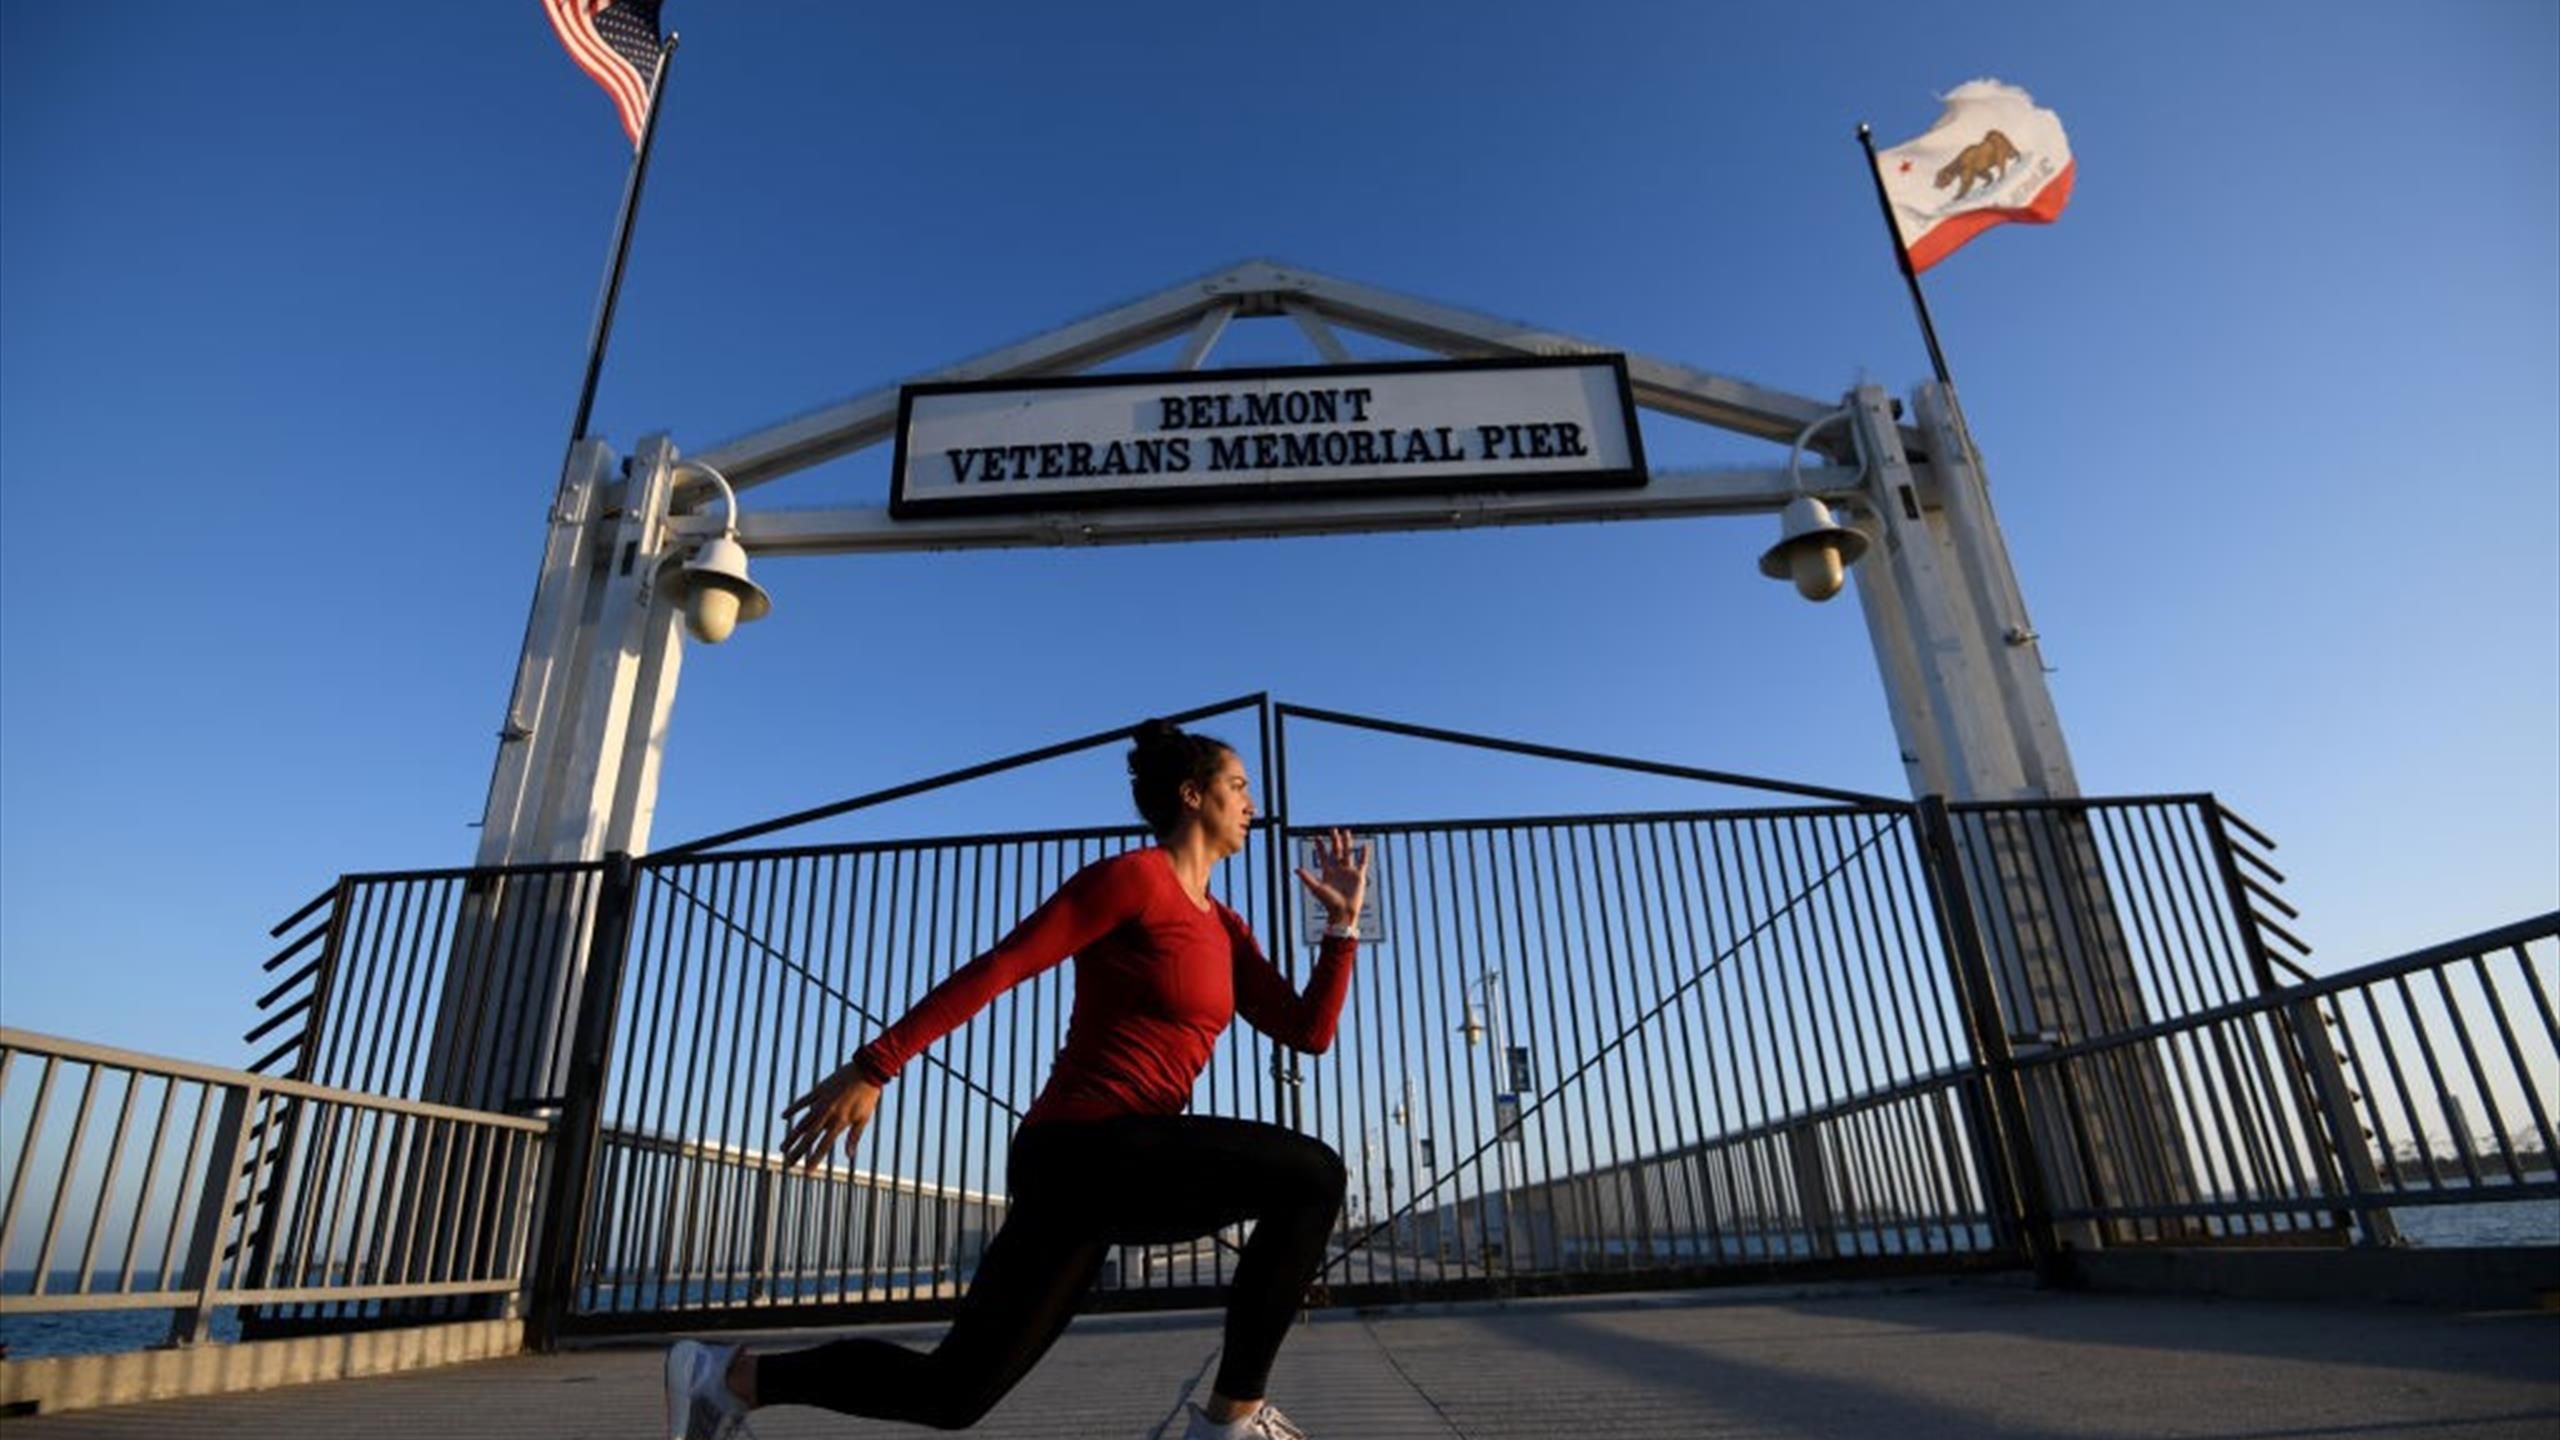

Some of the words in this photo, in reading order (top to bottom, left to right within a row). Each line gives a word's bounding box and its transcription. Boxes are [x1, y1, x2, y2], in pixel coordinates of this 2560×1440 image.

[1160, 389, 1371, 430] BELMONT
[946, 438, 1190, 483] VETERANS
[1208, 428, 1463, 470] MEMORIAL
[1480, 422, 1587, 459] PIER
